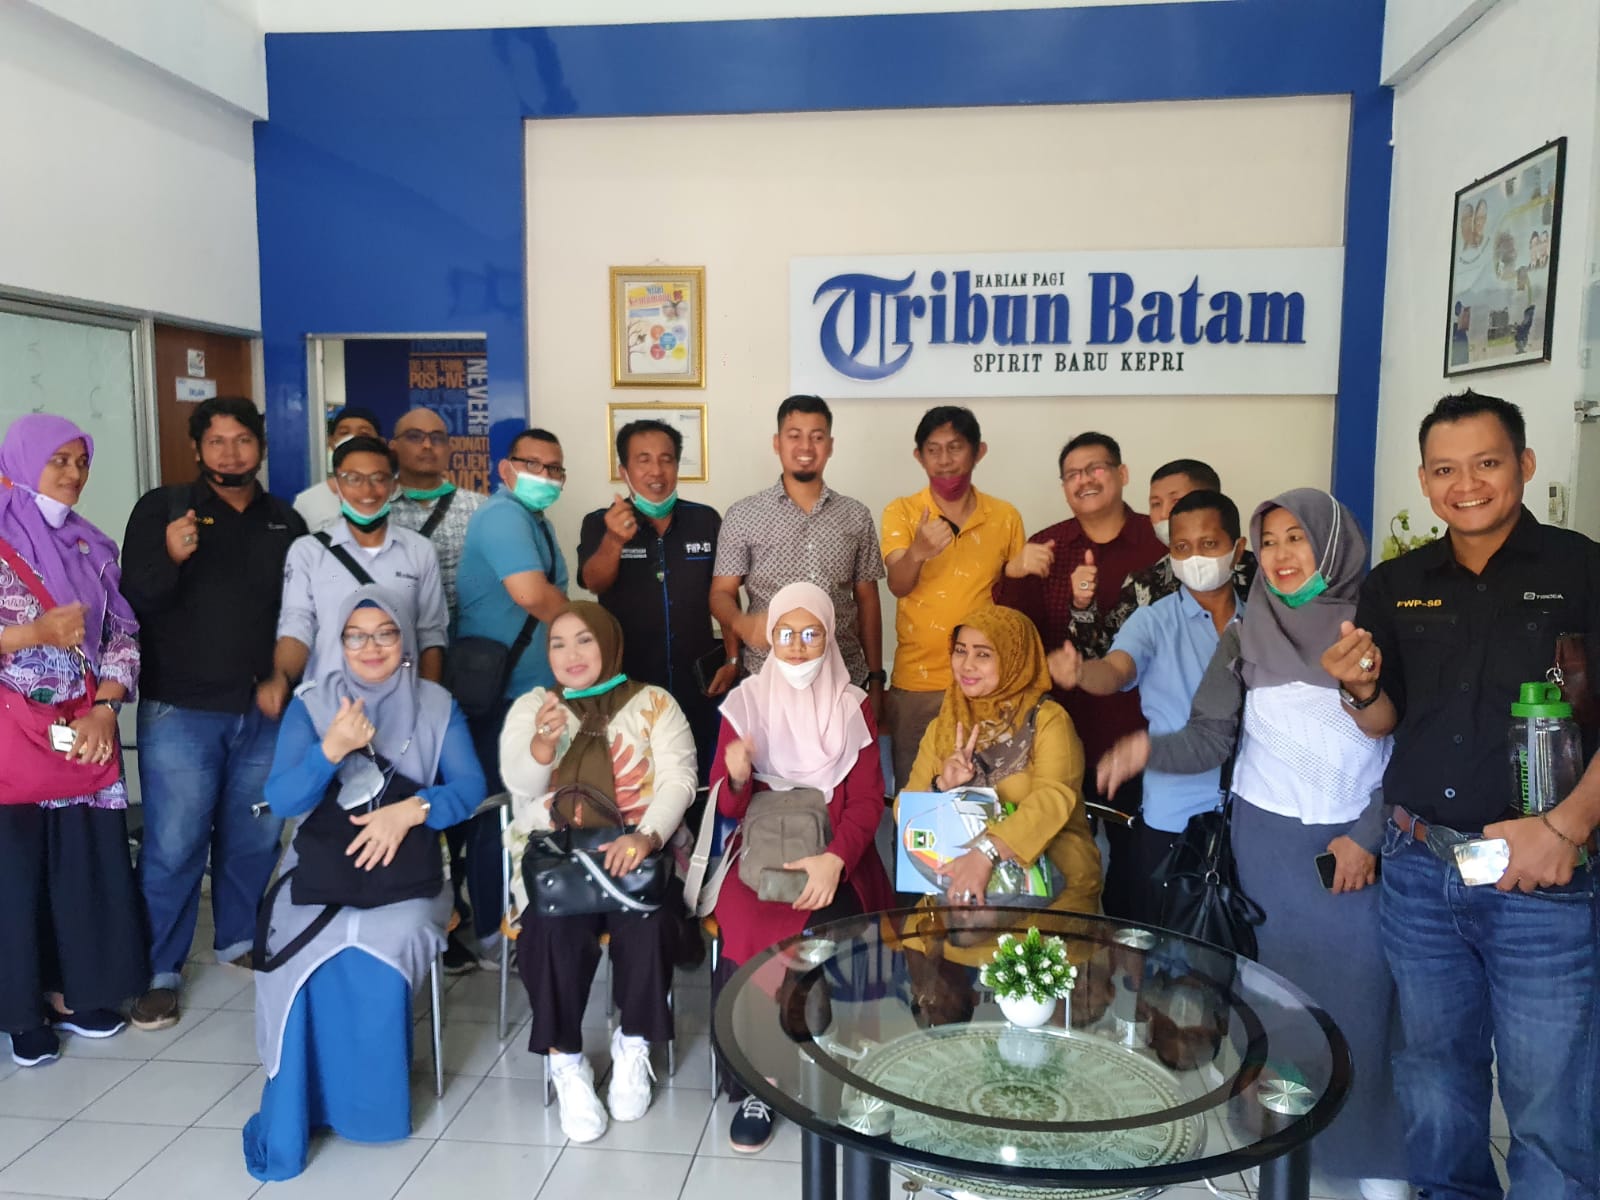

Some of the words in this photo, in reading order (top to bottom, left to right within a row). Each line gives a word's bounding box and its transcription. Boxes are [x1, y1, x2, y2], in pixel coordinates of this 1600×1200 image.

[975, 274, 1027, 288] HARIAN
[1032, 272, 1065, 287] PAGI
[812, 270, 1072, 381] Tribun
[1086, 272, 1306, 345] Batam
[973, 353, 1043, 373] SPIRIT
[1054, 351, 1109, 373] BARU
[1120, 351, 1185, 372] KEPRI
[466, 359, 489, 425] NEVER
